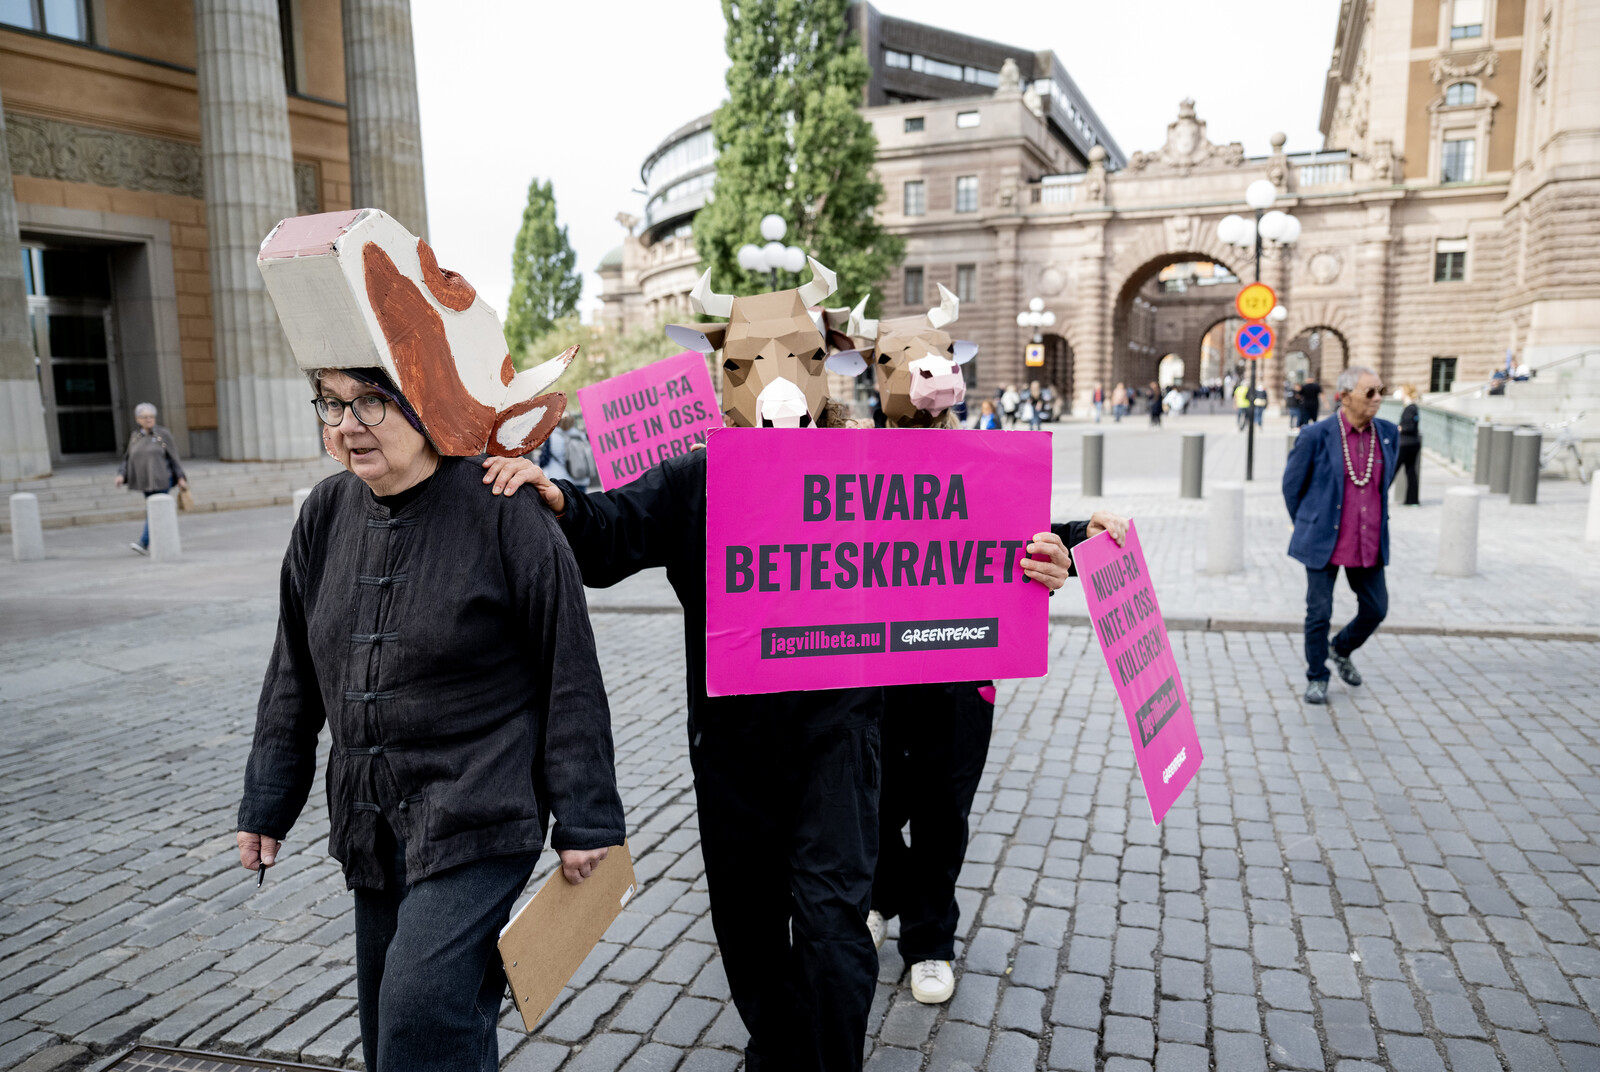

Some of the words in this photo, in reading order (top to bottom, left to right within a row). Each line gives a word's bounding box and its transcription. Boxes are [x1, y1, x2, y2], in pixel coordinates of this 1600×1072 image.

[602, 376, 693, 422] MUUU-RA
[598, 424, 639, 454] INTE
[643, 415, 664, 439] IN
[668, 401, 713, 429] OSS,
[803, 474, 969, 522] BEVARA
[1091, 552, 1141, 602] MUUU-RA
[901, 626, 989, 645] GREENPEACE
[1097, 607, 1126, 648] INTE
[1122, 599, 1138, 630] IN
[1133, 587, 1158, 621] OSS,
[770, 630, 880, 655] jagvillbeta.nu
[1115, 624, 1166, 687] KULLGREN!
